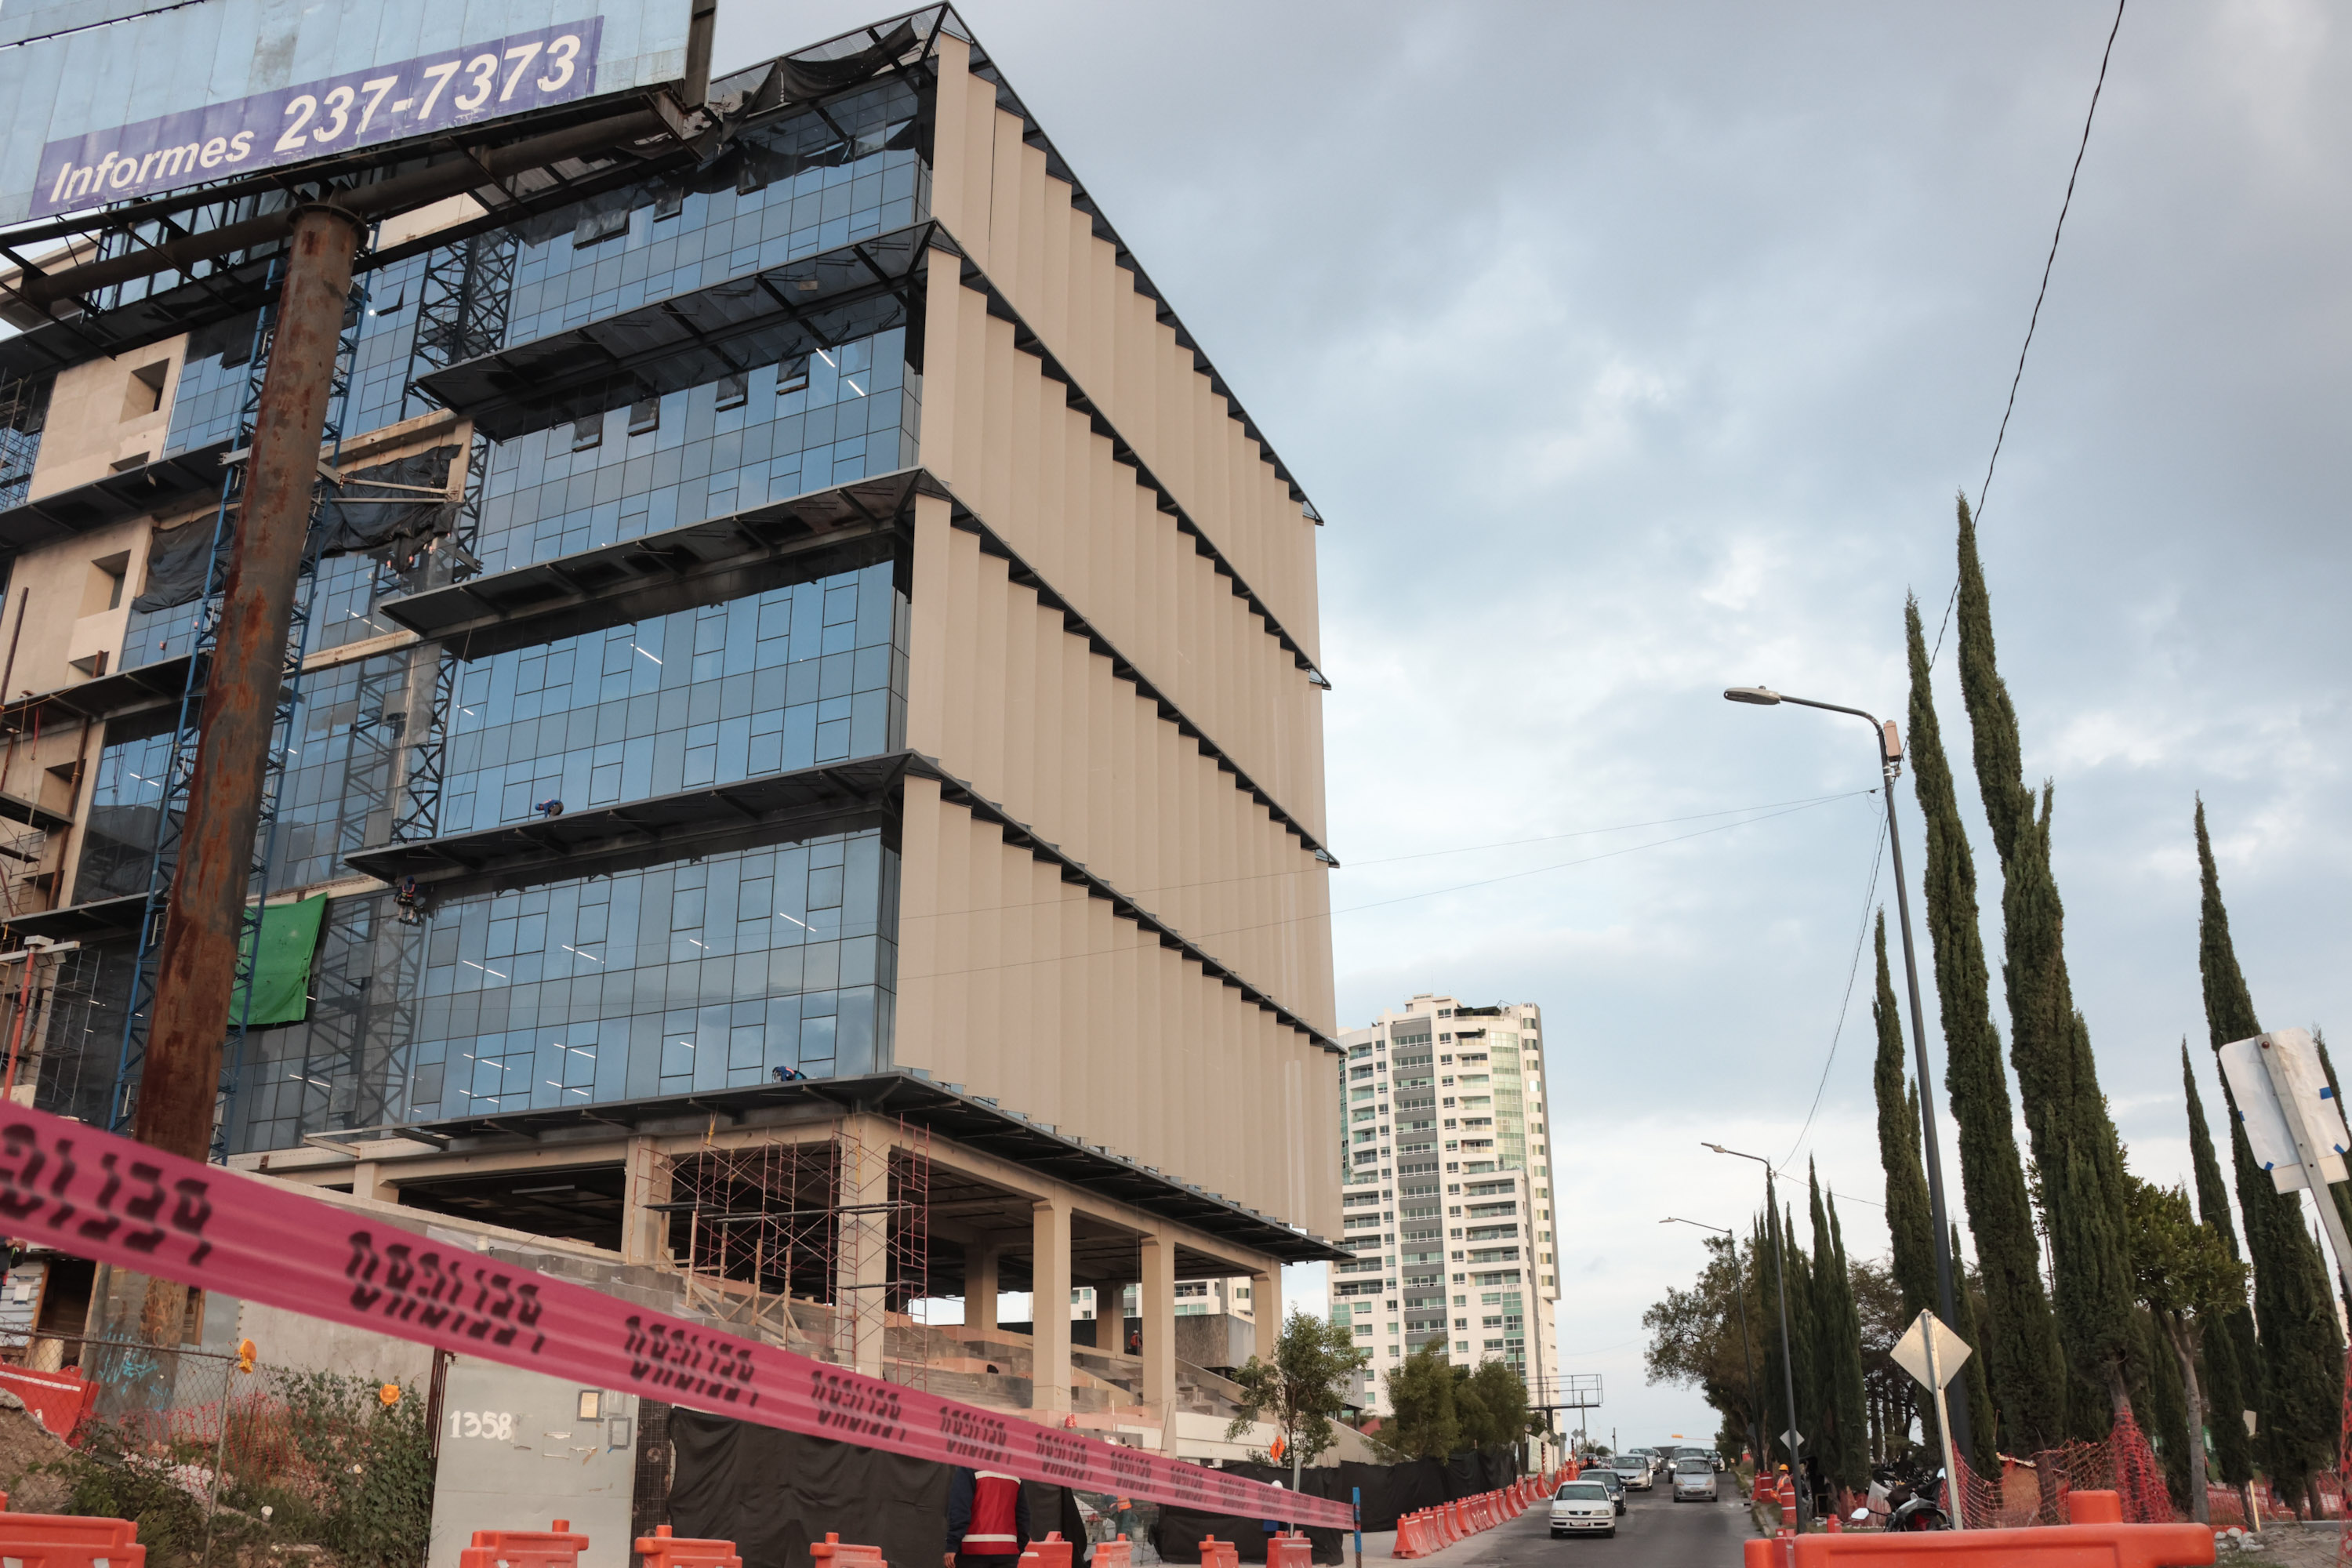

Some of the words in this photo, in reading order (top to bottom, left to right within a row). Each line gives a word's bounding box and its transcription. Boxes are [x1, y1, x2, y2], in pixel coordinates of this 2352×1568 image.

[49, 130, 254, 203] Informes
[273, 34, 583, 154] 237-7373
[449, 1410, 512, 1441] 1358
